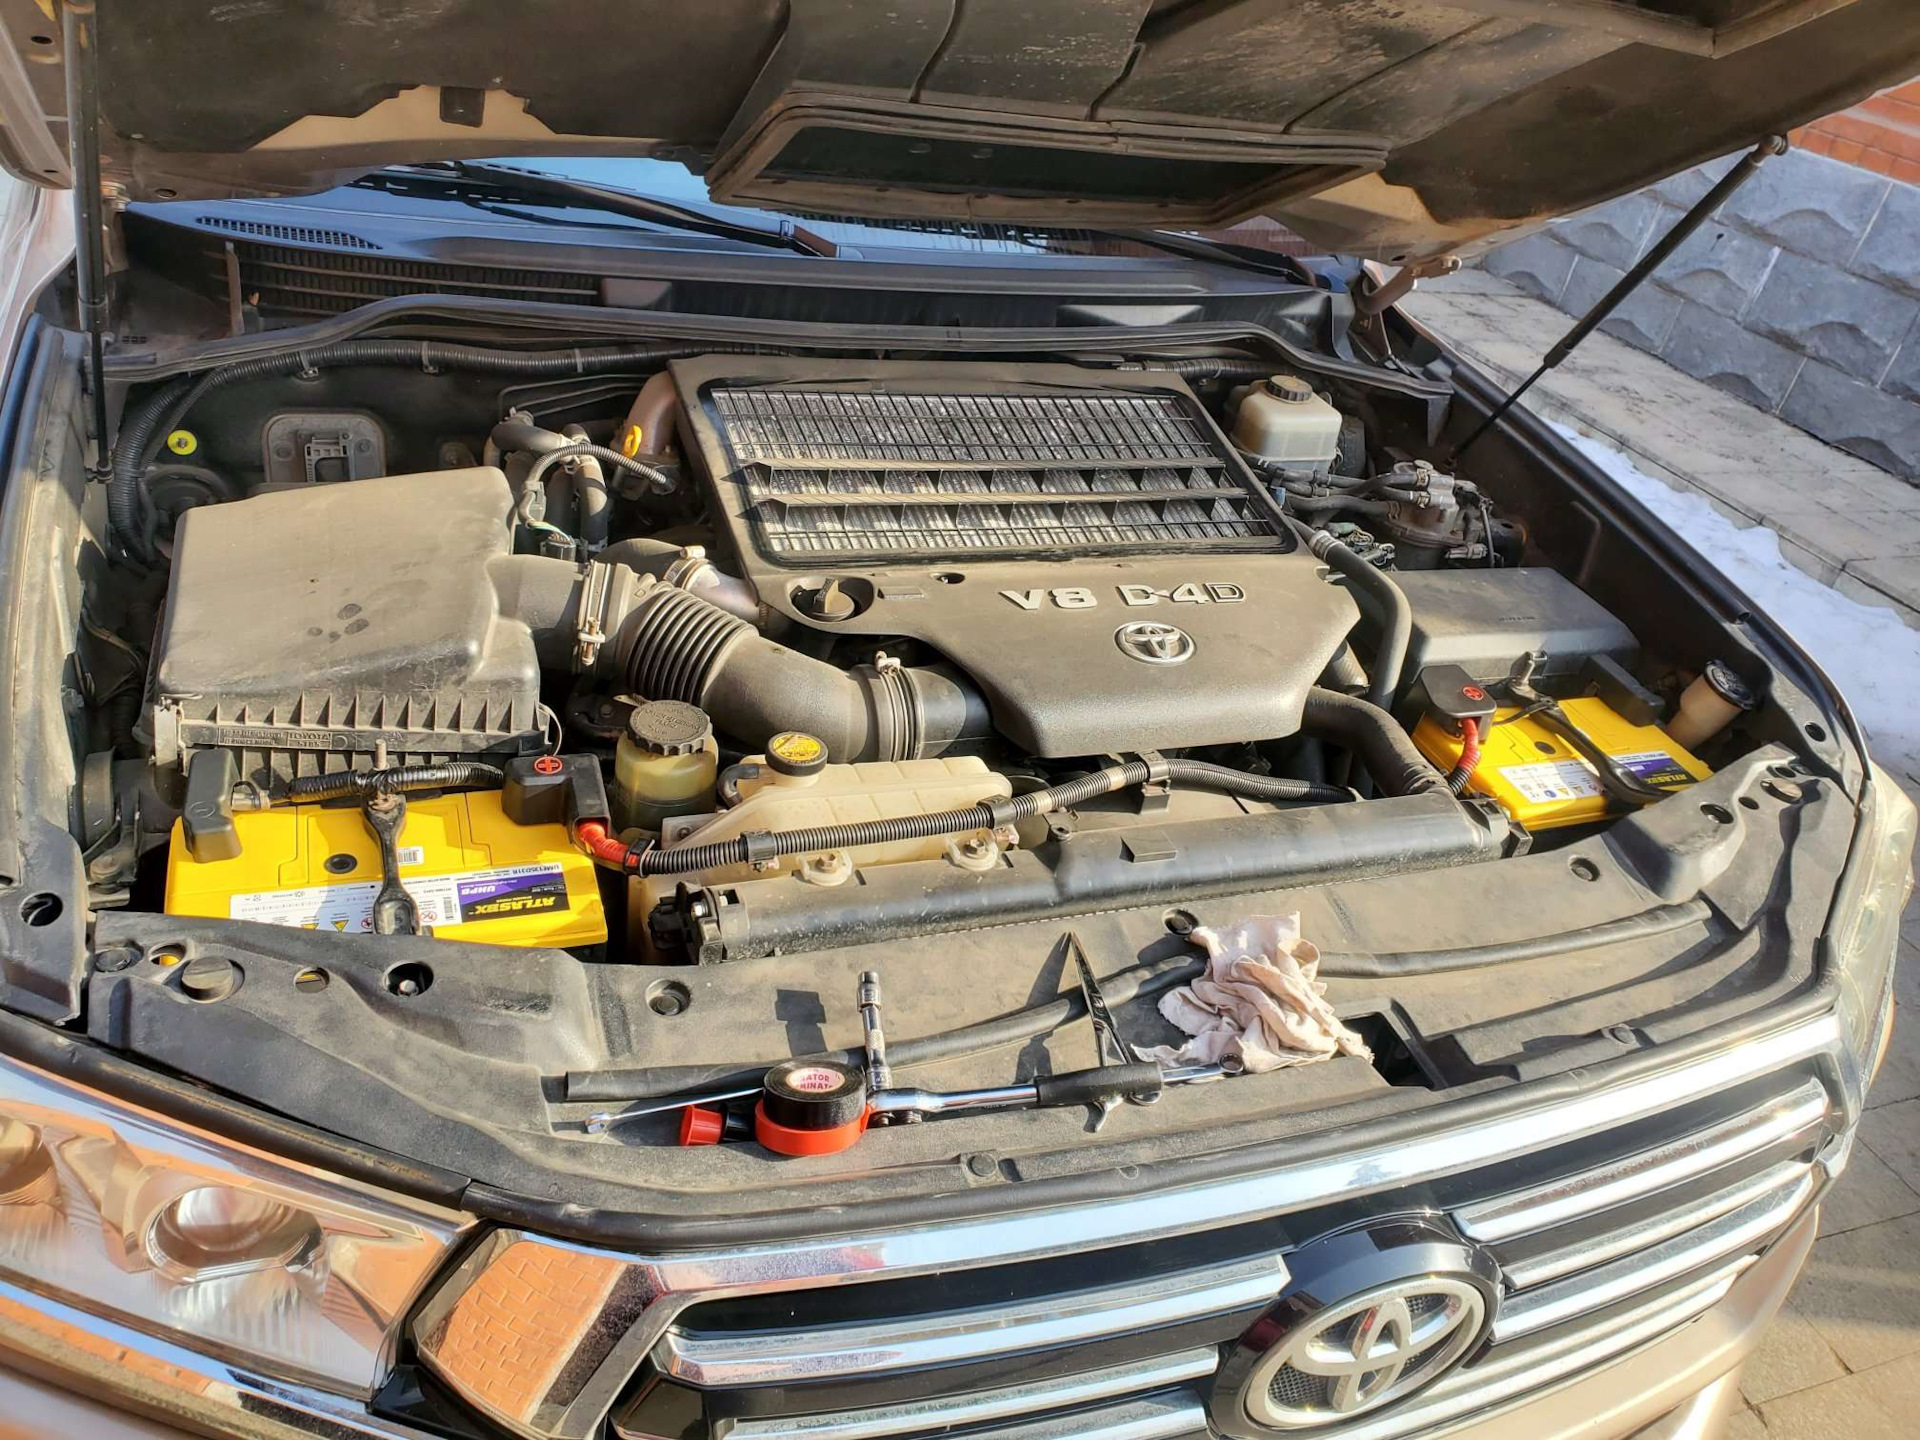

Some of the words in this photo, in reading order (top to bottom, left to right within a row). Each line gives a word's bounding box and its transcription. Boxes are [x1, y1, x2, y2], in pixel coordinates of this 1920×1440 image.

[1001, 587, 1098, 610] V8
[1117, 582, 1247, 606] D-4D
[290, 731, 331, 741] TOYOTA
[461, 885, 496, 895] UHPB
[474, 896, 556, 915] ATLASBX
